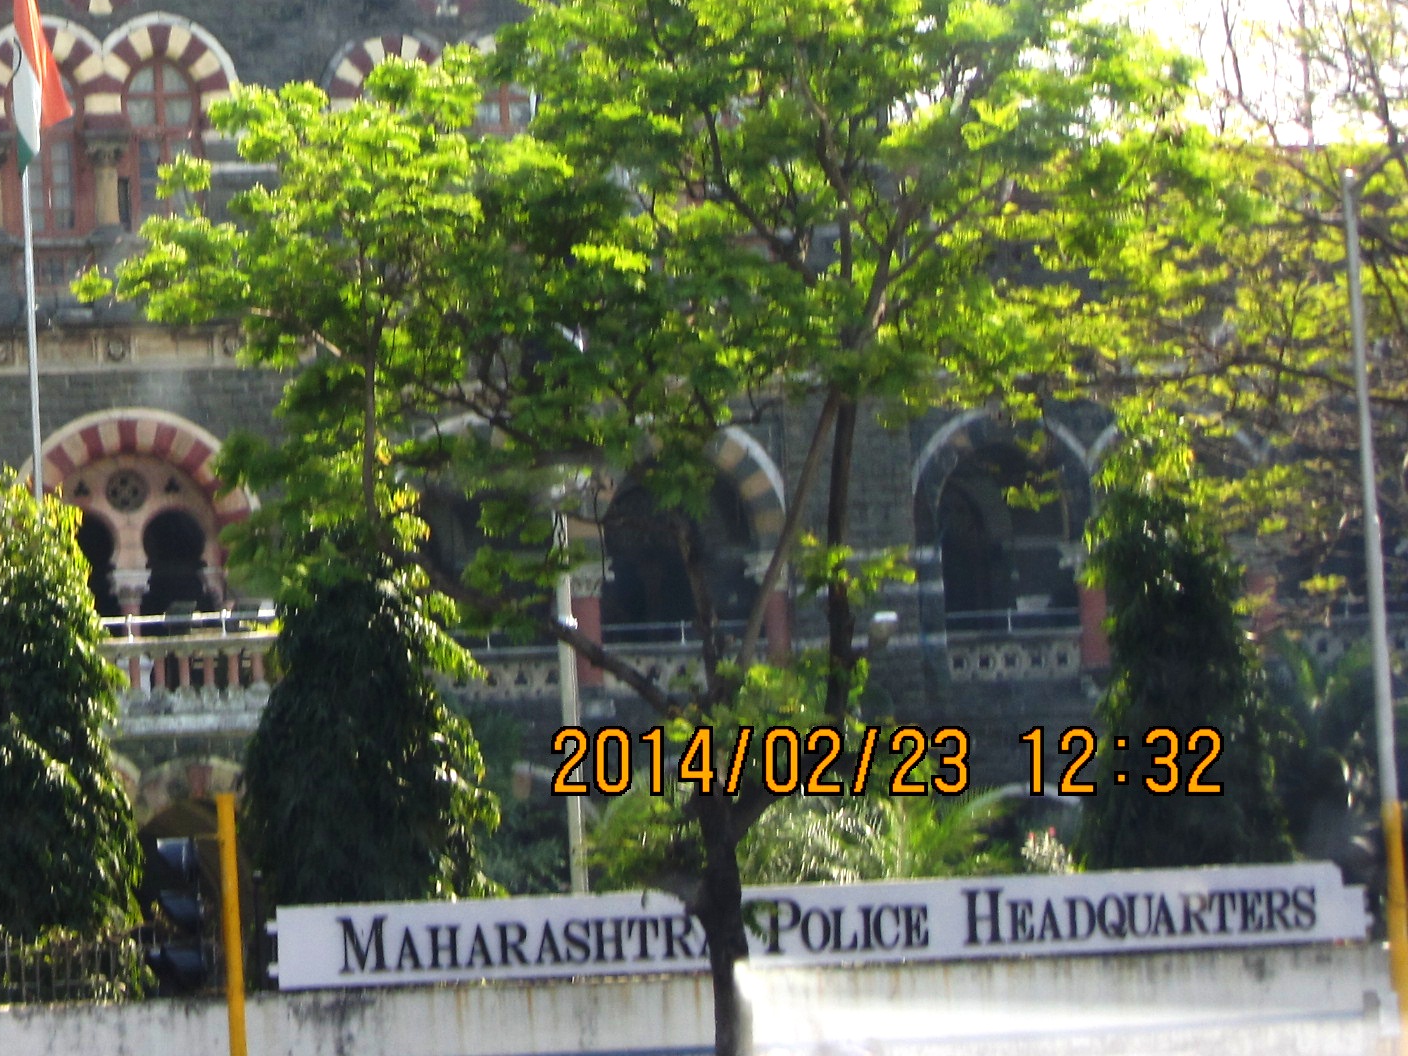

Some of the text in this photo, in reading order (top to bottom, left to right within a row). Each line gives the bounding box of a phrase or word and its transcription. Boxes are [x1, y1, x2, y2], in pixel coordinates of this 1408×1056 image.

[337, 886, 1317, 975] MAHARASHTR POLICE HEADQUARTERS
